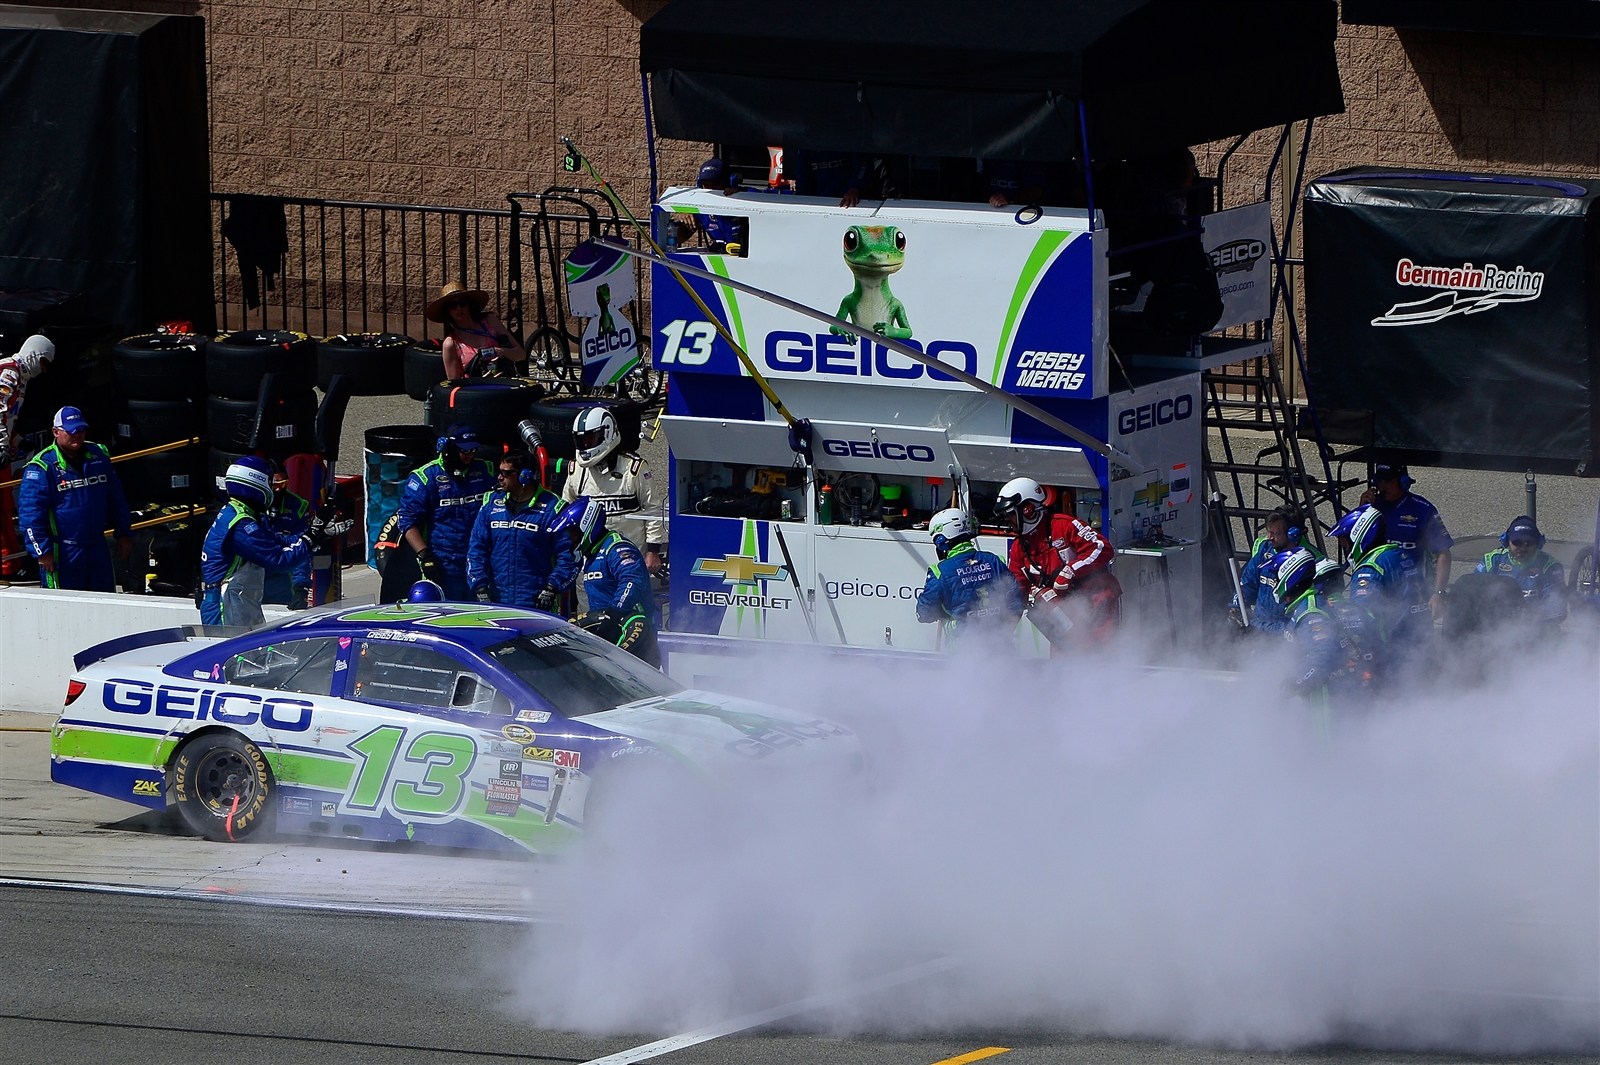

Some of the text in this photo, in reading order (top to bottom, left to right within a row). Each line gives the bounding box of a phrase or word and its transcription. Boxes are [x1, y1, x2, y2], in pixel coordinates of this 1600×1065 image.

[1209, 241, 1263, 267] GEICO
[1219, 280, 1255, 298] geico.com
[585, 328, 632, 358] GEICO
[660, 319, 719, 366] 13
[764, 330, 978, 383] GEICO
[1016, 350, 1086, 371] CASEY
[1016, 369, 1086, 391] MEARS
[1118, 393, 1193, 436] GEICO
[822, 439, 935, 462] GEICO
[57, 474, 108, 492] GEICO
[248, 471, 266, 483] GEICO
[440, 493, 484, 507] GEICO
[490, 520, 539, 532] GEICO
[582, 505, 594, 526] GEICO
[1352, 517, 1367, 537] GEICO
[27, 528, 43, 555] GEICO
[956, 563, 992, 576] PLOURDE
[1280, 557, 1297, 574] GEICO
[825, 578, 926, 600] geico.co
[690, 590, 793, 610] CHEVROLET
[530, 633, 568, 649] MEARS
[102, 678, 315, 732] GEICO
[723, 719, 854, 760] GEICO
[555, 750, 580, 768] 3M
[175, 755, 190, 803] EAGLE
[337, 724, 478, 825] 13
[489, 779, 517, 787] LINCOLN
[133, 780, 160, 792] ZAK
[236, 743, 269, 830] GOODYEAR
[486, 791, 519, 801] FLOWMASTER
